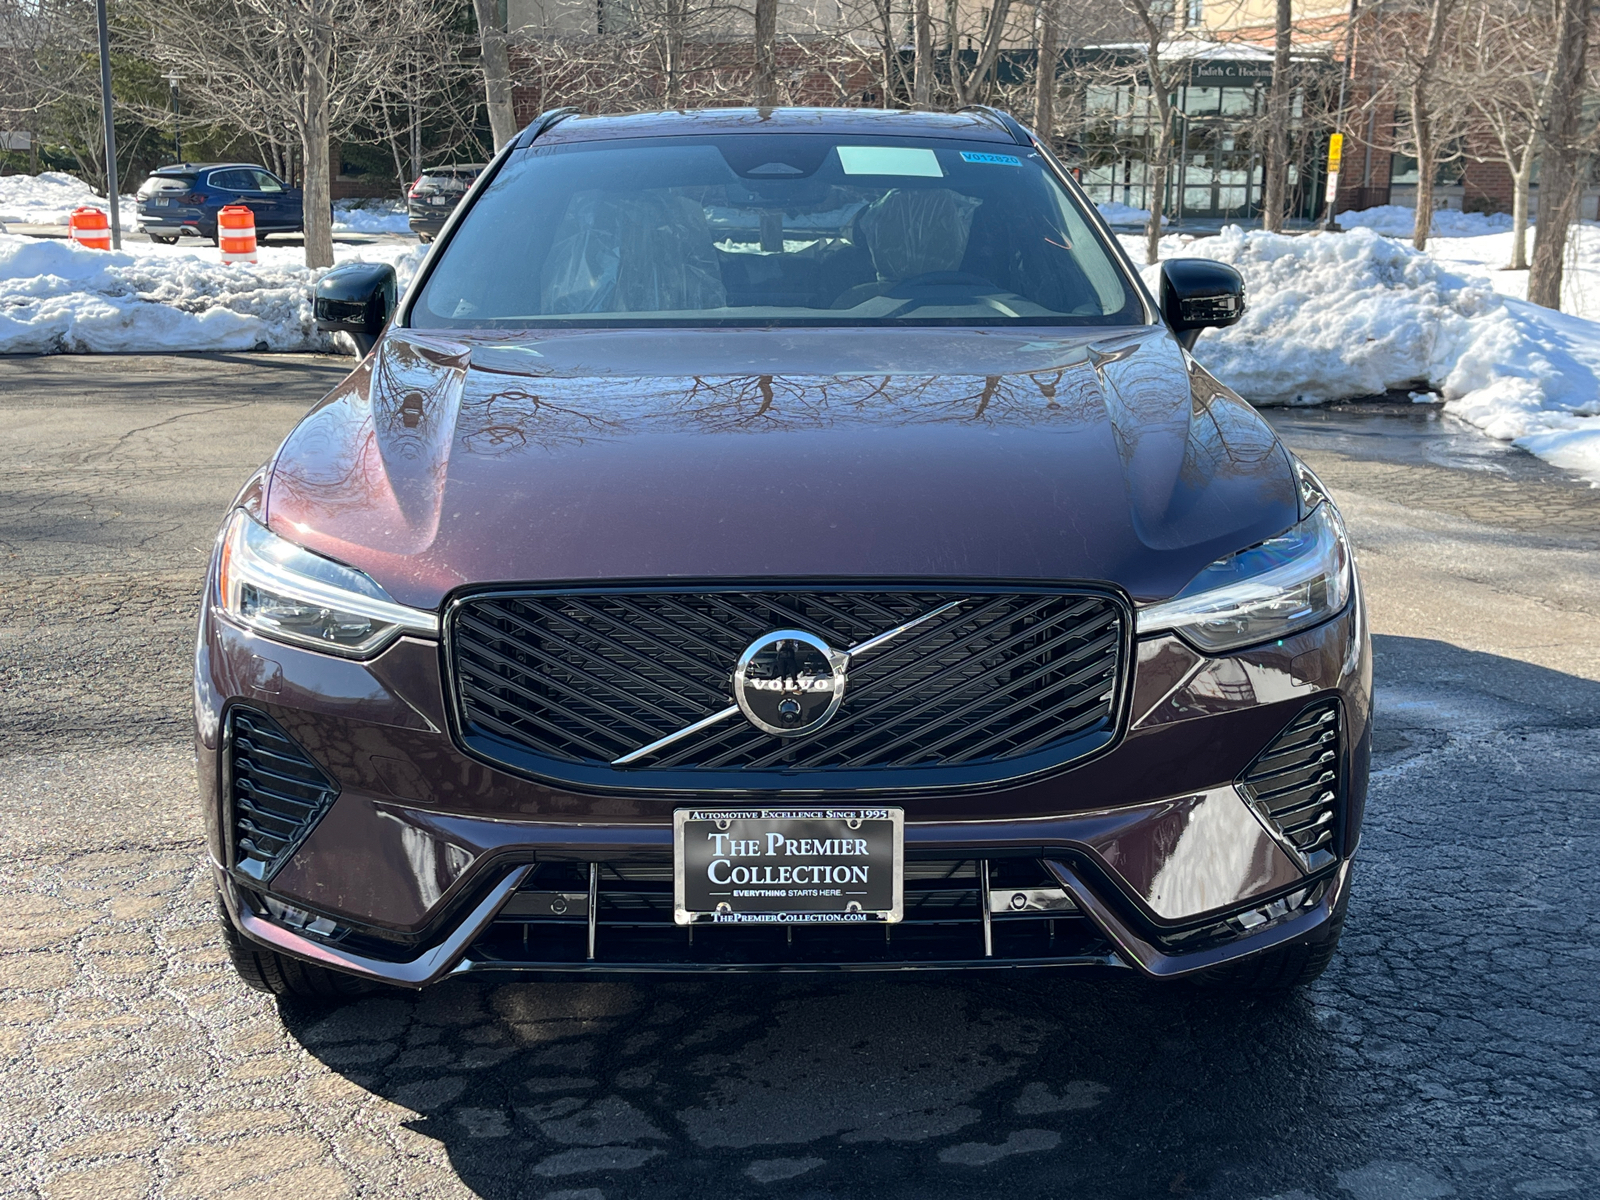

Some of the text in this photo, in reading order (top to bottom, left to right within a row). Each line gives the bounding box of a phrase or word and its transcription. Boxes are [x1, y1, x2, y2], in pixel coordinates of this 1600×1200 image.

[1196, 66, 1273, 78] Judith C. Hochma
[751, 680, 828, 690] VOLVO
[692, 810, 887, 819] AUTOMOTIVE EXCELLENCE SINCE 1995
[707, 833, 869, 856] THE PREMIER
[707, 859, 869, 885] COLLECTION
